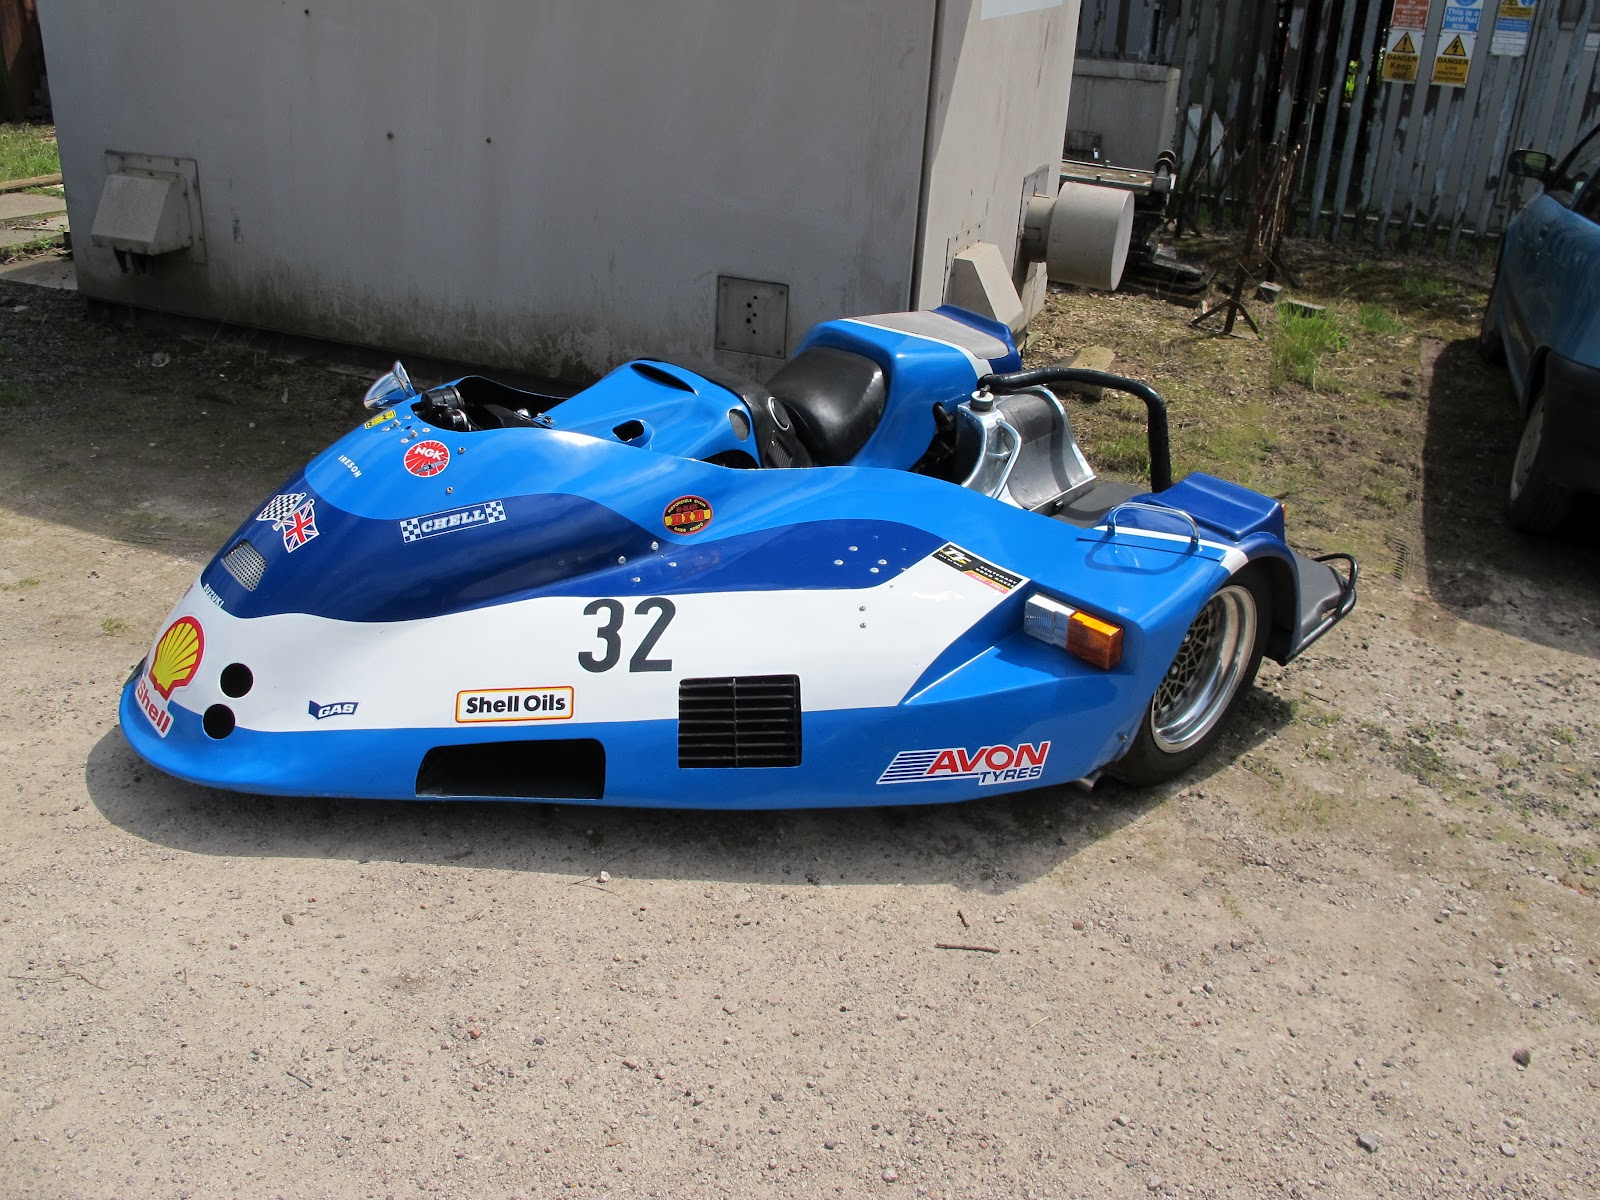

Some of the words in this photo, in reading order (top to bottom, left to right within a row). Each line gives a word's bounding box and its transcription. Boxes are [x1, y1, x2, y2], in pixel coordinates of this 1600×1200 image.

[1448, 8, 1463, 16] This
[1387, 54, 1418, 62] DANGER
[1390, 62, 1411, 71] Keep
[1437, 57, 1469, 65] DANGER
[414, 446, 445, 461] NGK
[338, 454, 363, 478] IRESON
[421, 509, 486, 534] CHELL
[980, 565, 1018, 584] CENTENARY
[203, 583, 225, 608] SUZUKI
[578, 597, 676, 673] 32
[137, 680, 171, 733] Shell
[317, 704, 354, 718] GAS
[466, 695, 519, 714] Shell
[523, 694, 566, 712] Oils
[926, 742, 1049, 774] AVON
[979, 766, 1042, 783] TYRES
